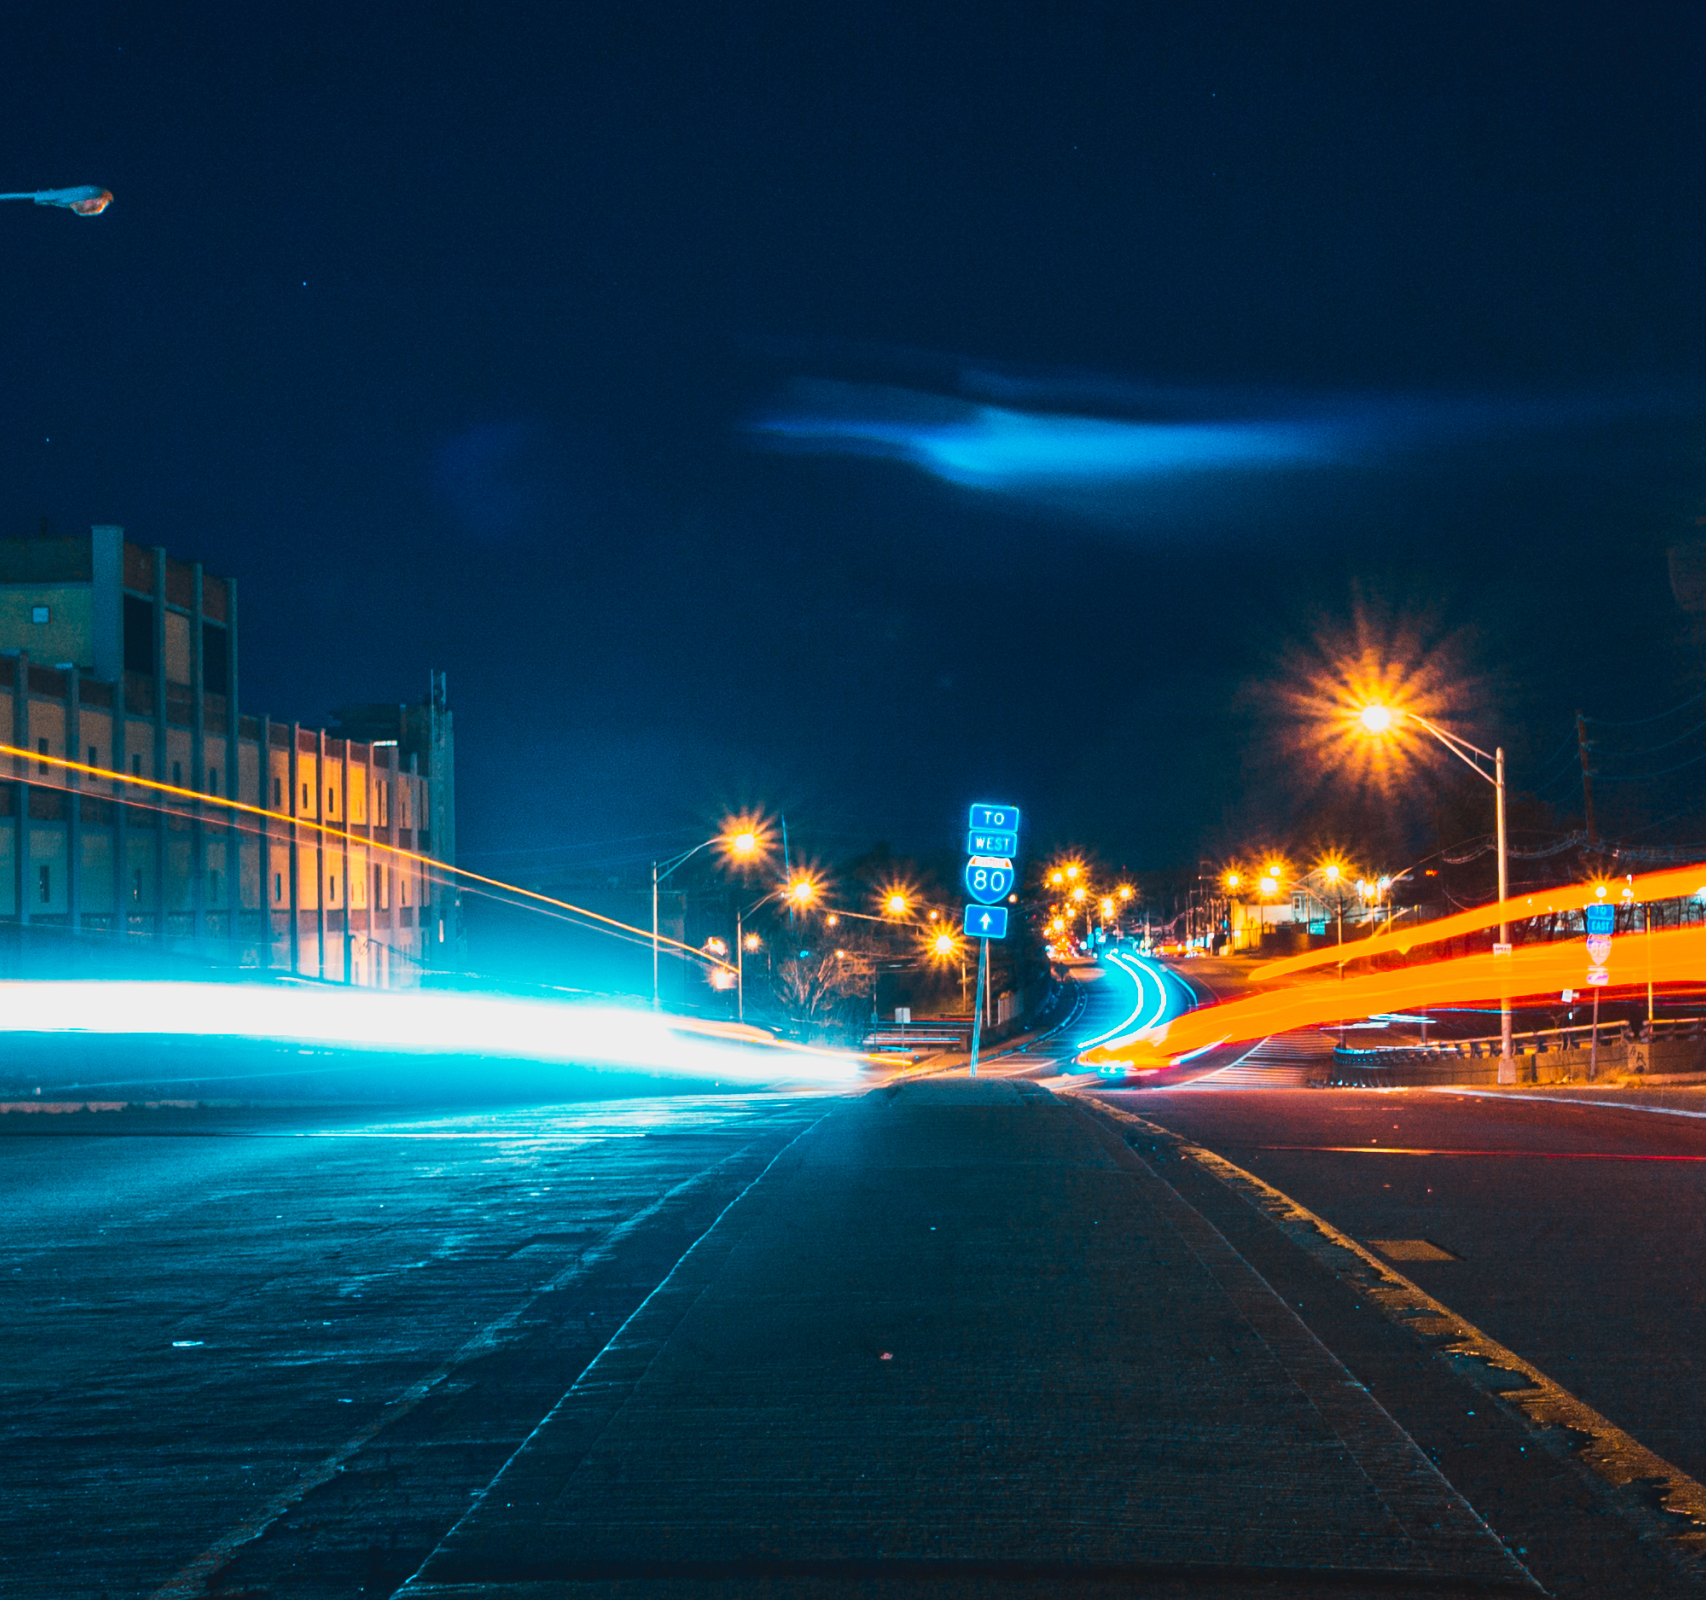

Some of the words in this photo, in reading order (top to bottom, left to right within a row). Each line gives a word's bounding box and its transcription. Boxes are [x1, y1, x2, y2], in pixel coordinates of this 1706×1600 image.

[984, 811, 1004, 825] TO
[976, 836, 1010, 852] WEST
[974, 869, 1004, 892] 80
[1591, 921, 1610, 931] EAST
